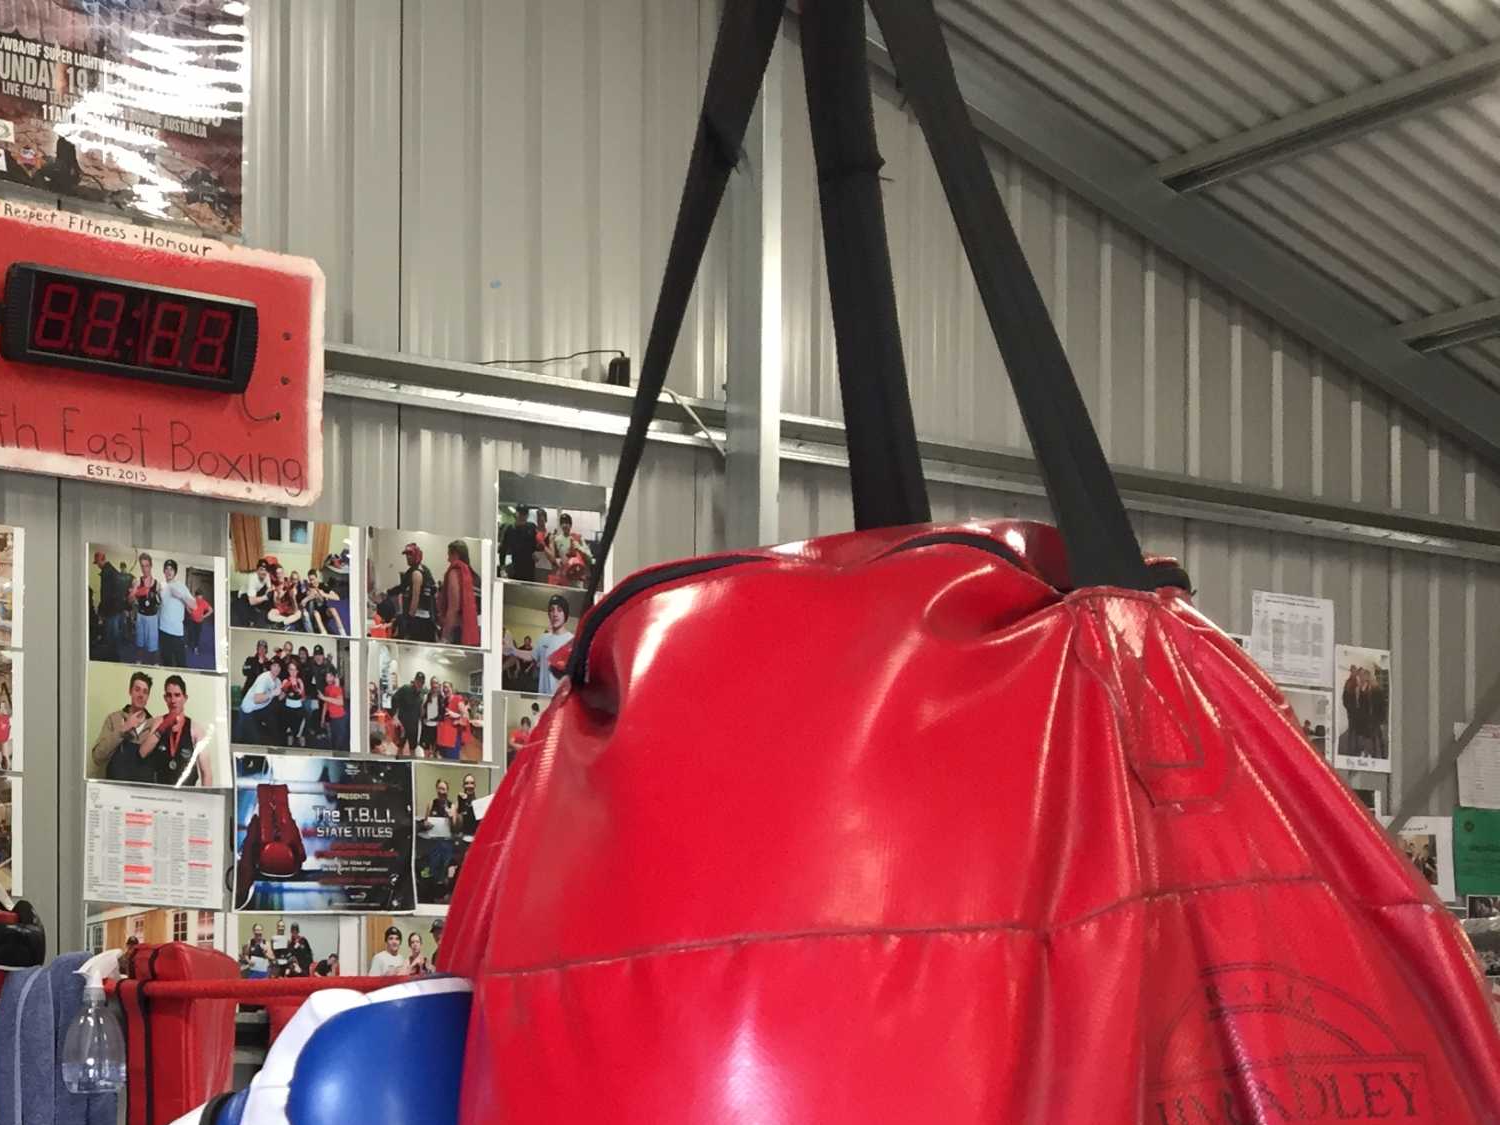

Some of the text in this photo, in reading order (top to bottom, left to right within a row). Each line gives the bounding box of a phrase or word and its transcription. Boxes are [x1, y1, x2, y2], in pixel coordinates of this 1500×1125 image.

[43, 42, 73, 64] SUPER
[2, 81, 24, 97] LIVE
[3, 202, 57, 226] Respect
[142, 228, 213, 257] Honour
[60, 406, 150, 471] East
[169, 420, 304, 498] Boxing
[312, 805, 341, 823] The
[316, 826, 393, 838] STATE TITLES
